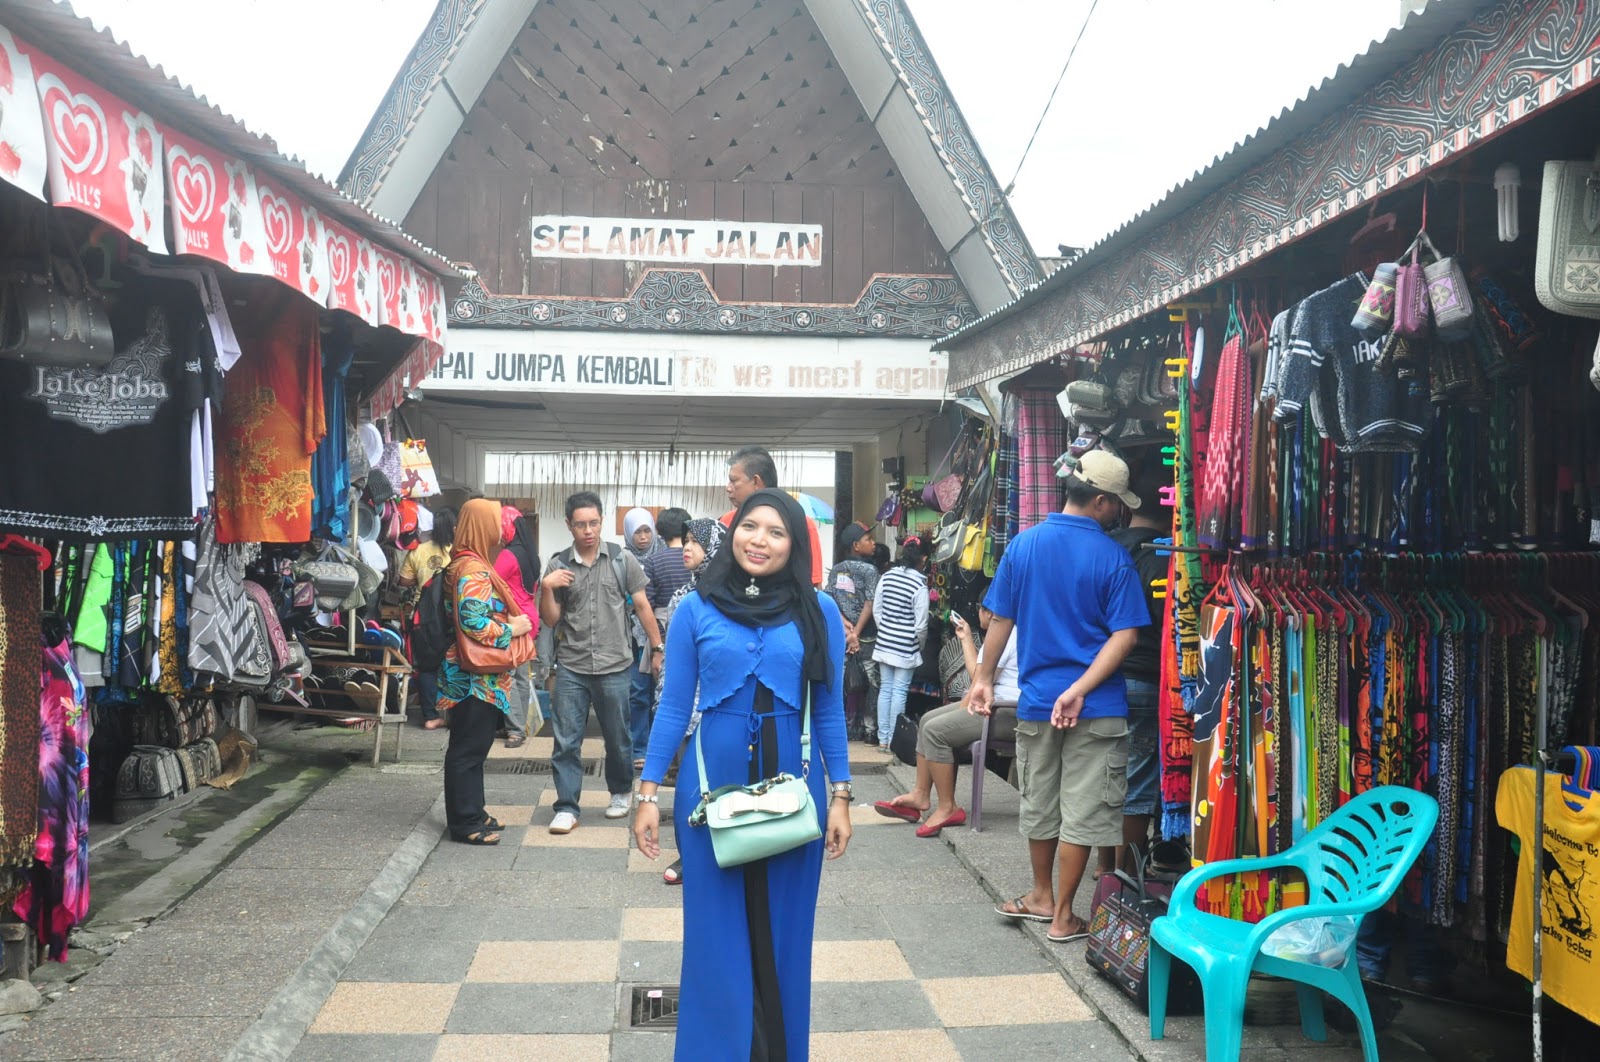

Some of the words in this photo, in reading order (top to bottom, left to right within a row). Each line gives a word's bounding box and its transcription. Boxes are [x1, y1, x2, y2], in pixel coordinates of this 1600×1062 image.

[69, 178, 101, 209] ALL'S
[533, 224, 695, 257] SELAMAT
[704, 229, 821, 261] JALAN
[31, 366, 101, 397] Lake
[104, 372, 168, 402] Toba
[432, 351, 474, 379] PAI
[486, 352, 566, 382] JUMPA
[577, 355, 673, 386] KEMBALI
[733, 364, 772, 388] we
[0, 513, 16, 522] ake
[17, 514, 40, 525] Toba
[41, 517, 65, 527] Lake
[111, 520, 132, 530] Lake
[132, 519, 153, 529] Toba
[1542, 925, 1563, 943] ake
[1566, 935, 1592, 958] Toba
